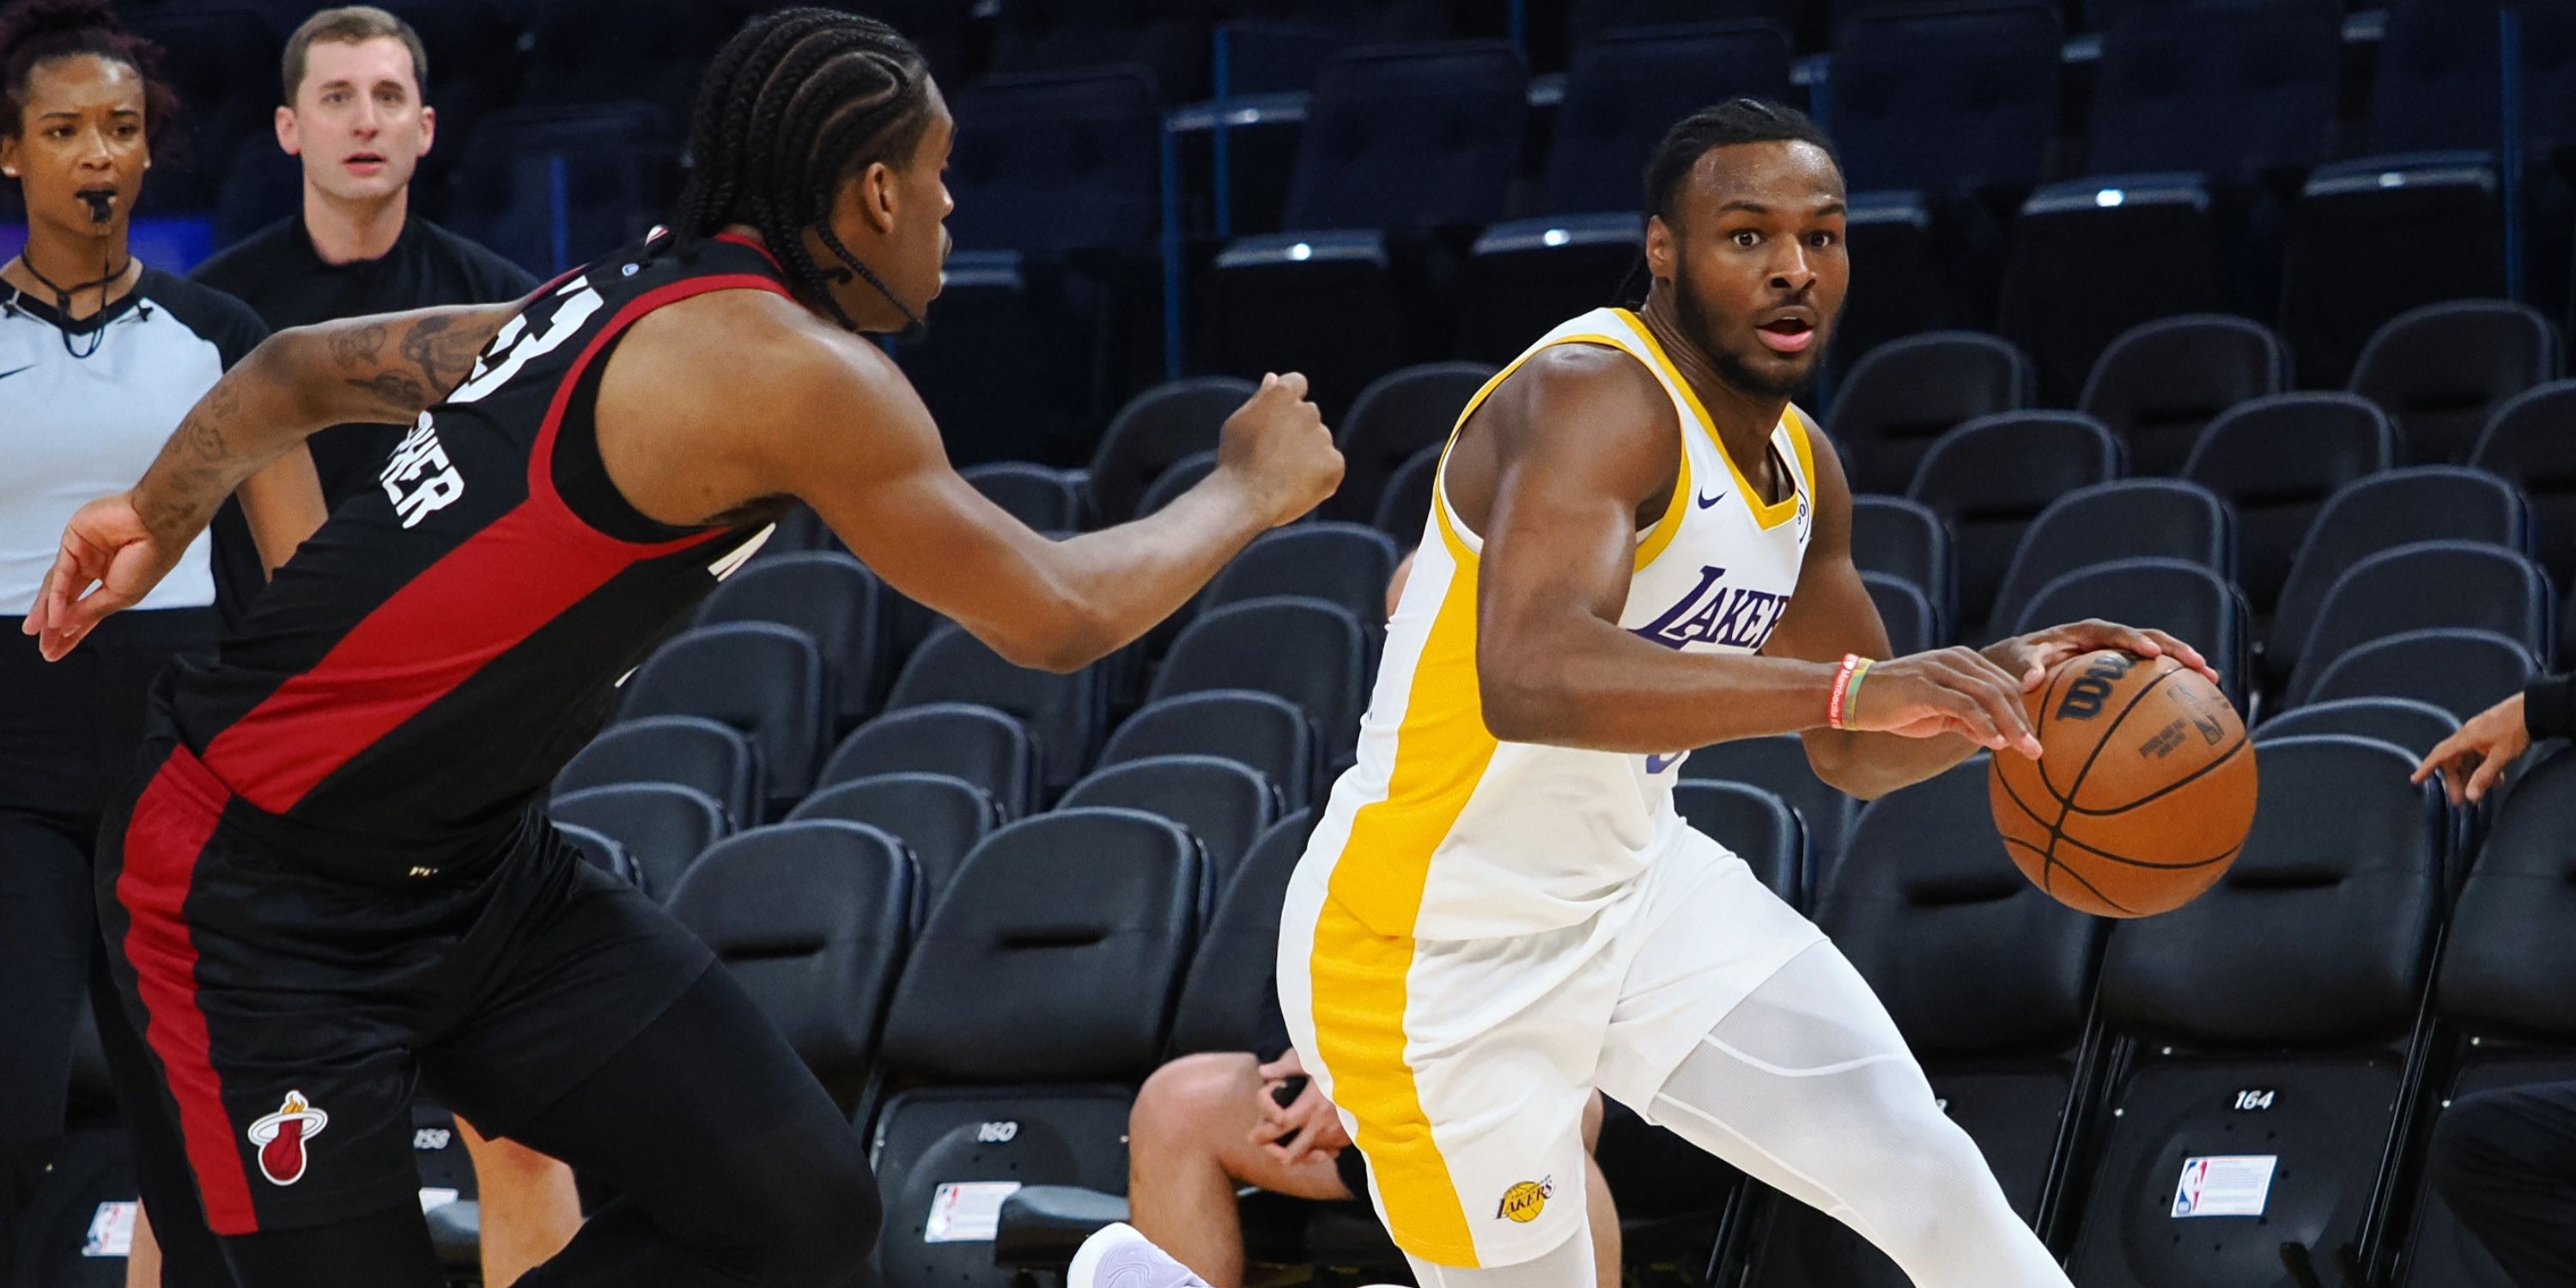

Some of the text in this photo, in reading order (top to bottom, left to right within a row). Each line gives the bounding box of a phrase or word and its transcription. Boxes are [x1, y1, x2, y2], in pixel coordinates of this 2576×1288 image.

[2234, 1090, 2275, 1110] 164
[977, 1121, 1018, 1143] 160
[1493, 1179, 1556, 1220] LAKERS
